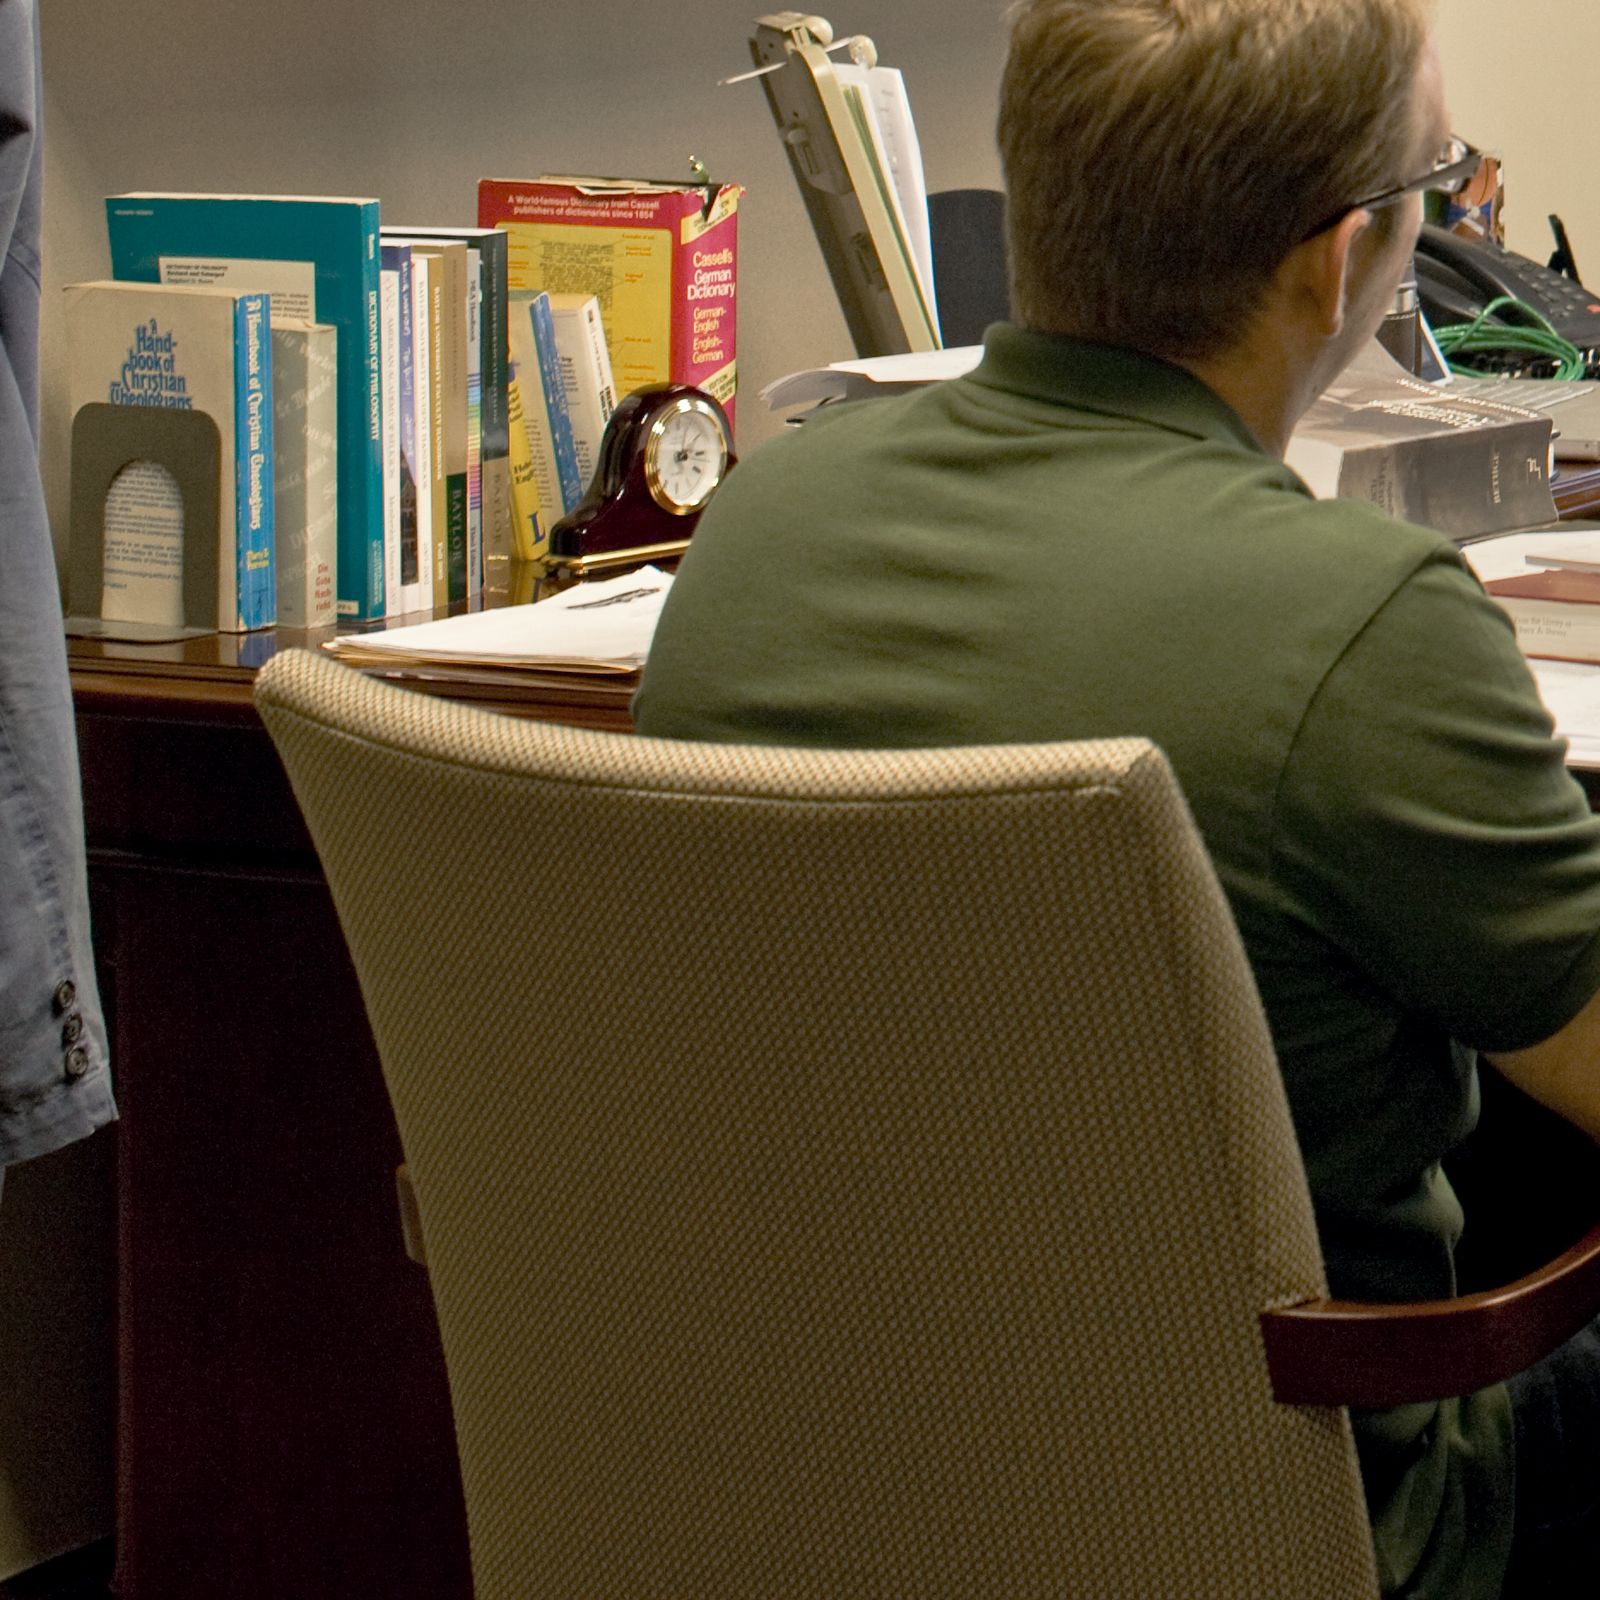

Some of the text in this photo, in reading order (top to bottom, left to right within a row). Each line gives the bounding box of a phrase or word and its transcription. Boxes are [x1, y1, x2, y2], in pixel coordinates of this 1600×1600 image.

[508, 195, 660, 210] A World-famous Dictionary from Cassell
[514, 205, 654, 220] publishers of dictionaries since 1854
[693, 248, 733, 268] Cassell's
[687, 280, 735, 300] Dictionary
[694, 270, 732, 286] German
[418, 281, 426, 319] BAYLOR
[433, 287, 441, 323] BAYLOR
[693, 307, 727, 320] German-
[468, 302, 477, 343] Handbook
[693, 319, 720, 336] English
[136, 325, 178, 352] Hand-
[247, 314, 262, 375] Handbook
[419, 321, 427, 382] UNIVERSITY
[693, 336, 723, 352] English-
[128, 350, 176, 373] book of
[367, 291, 380, 441] DICTIONARY OF PHILOSOPHY
[434, 325, 442, 382] UNIVERSITY
[692, 349, 724, 364] German
[122, 364, 186, 394] Christian
[248, 378, 262, 390] of
[109, 382, 192, 409] Theologians
[246, 391, 263, 450] Christian
[435, 427, 443, 480] HANDBOOK
[247, 454, 265, 530] Theologians
[492, 473, 503, 546] BAYLOR
[450, 489, 463, 562] BAYLOR
[317, 563, 329, 574] Die
[470, 550, 478, 577] Edition
[315, 575, 331, 587] Gute
